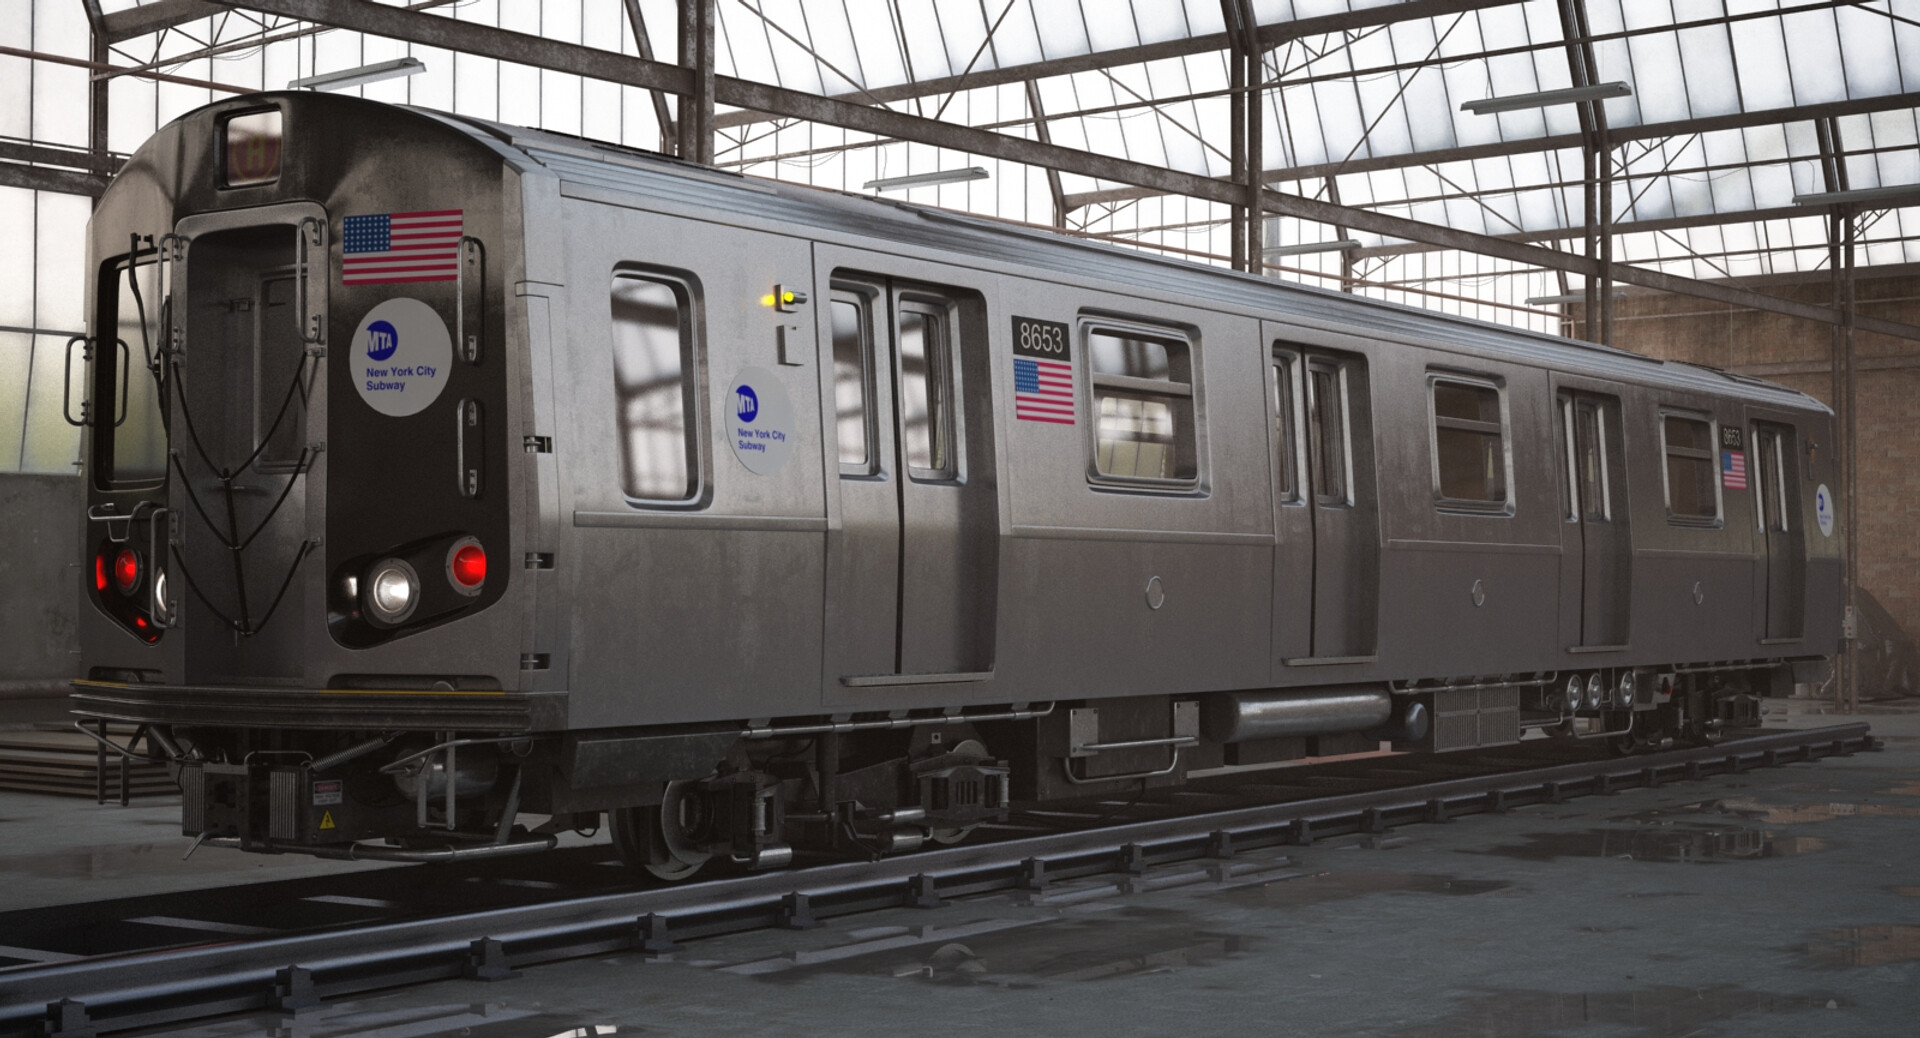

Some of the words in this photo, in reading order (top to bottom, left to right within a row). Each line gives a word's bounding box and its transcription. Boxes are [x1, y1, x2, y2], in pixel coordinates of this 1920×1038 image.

[365, 328, 394, 354] MTA
[1020, 322, 1063, 353] 8653
[366, 367, 388, 377] New
[390, 366, 413, 377] York
[416, 365, 437, 378] City
[366, 380, 406, 392] Subway
[736, 390, 756, 416] MTA
[737, 428, 753, 437] New
[754, 429, 771, 439] York
[771, 430, 786, 443] City
[738, 439, 766, 453] Subway
